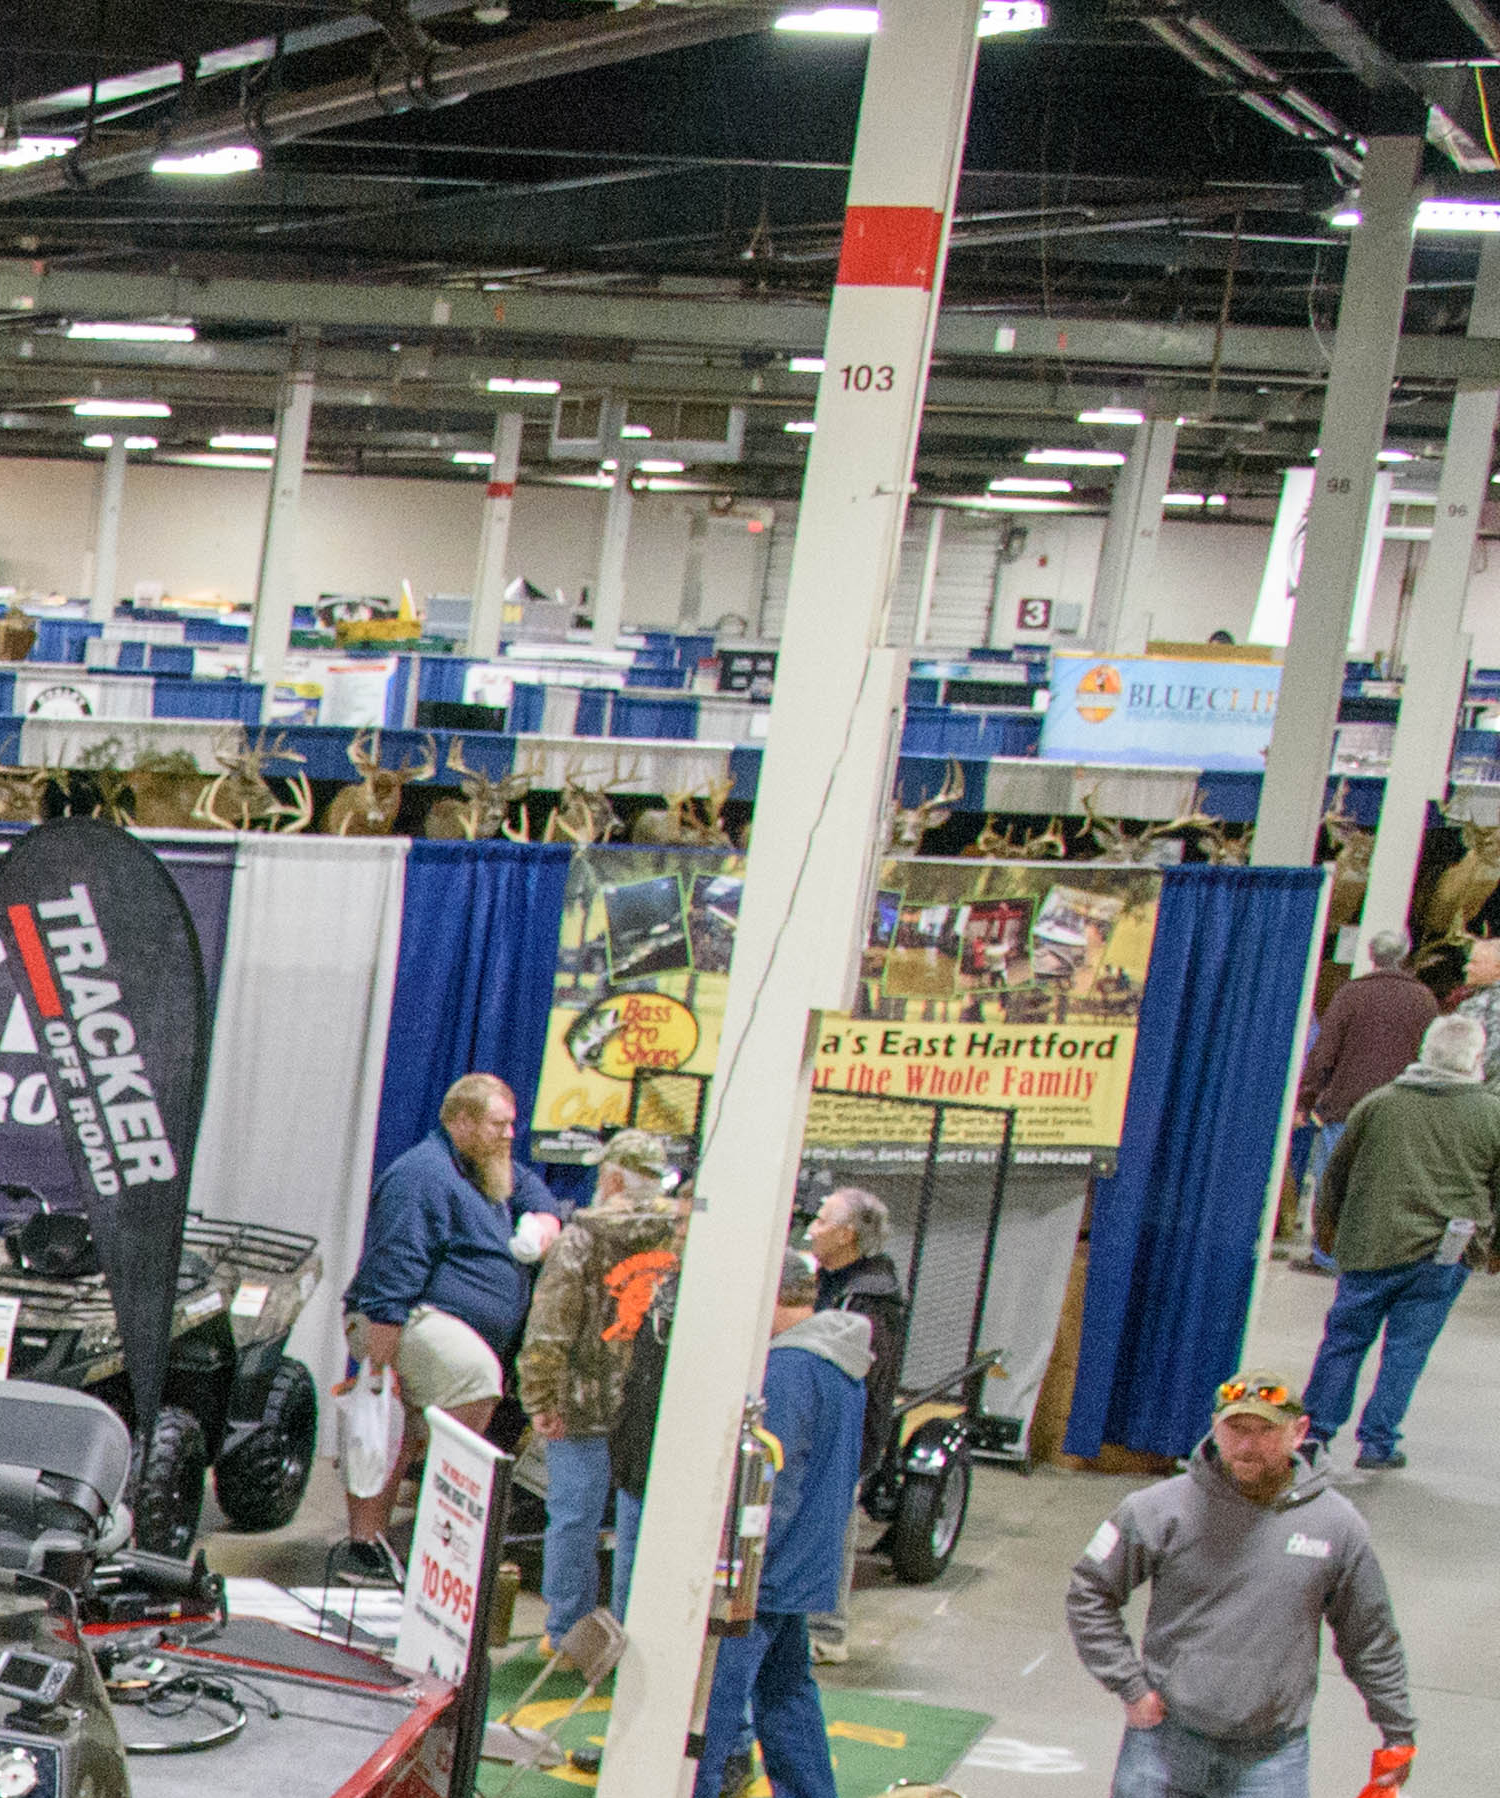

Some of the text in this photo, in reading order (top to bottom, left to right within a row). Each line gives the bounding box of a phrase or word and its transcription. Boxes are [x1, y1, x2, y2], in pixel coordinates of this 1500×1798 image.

[840, 364, 894, 393] 103
[1022, 601, 1047, 627] 3
[1127, 684, 1274, 714] BLUECLI
[622, 998, 672, 1024] Bass
[37, 883, 178, 1187] TRACKER
[621, 1023, 660, 1045] Pro
[879, 1030, 956, 1057] East
[965, 1032, 1119, 1060] Hartford
[617, 1043, 679, 1068] Shops
[846, 1064, 892, 1094] the
[906, 1065, 990, 1097] Whole
[1002, 1066, 1097, 1101] Family
[45, 1020, 121, 1197] OFF ROAD
